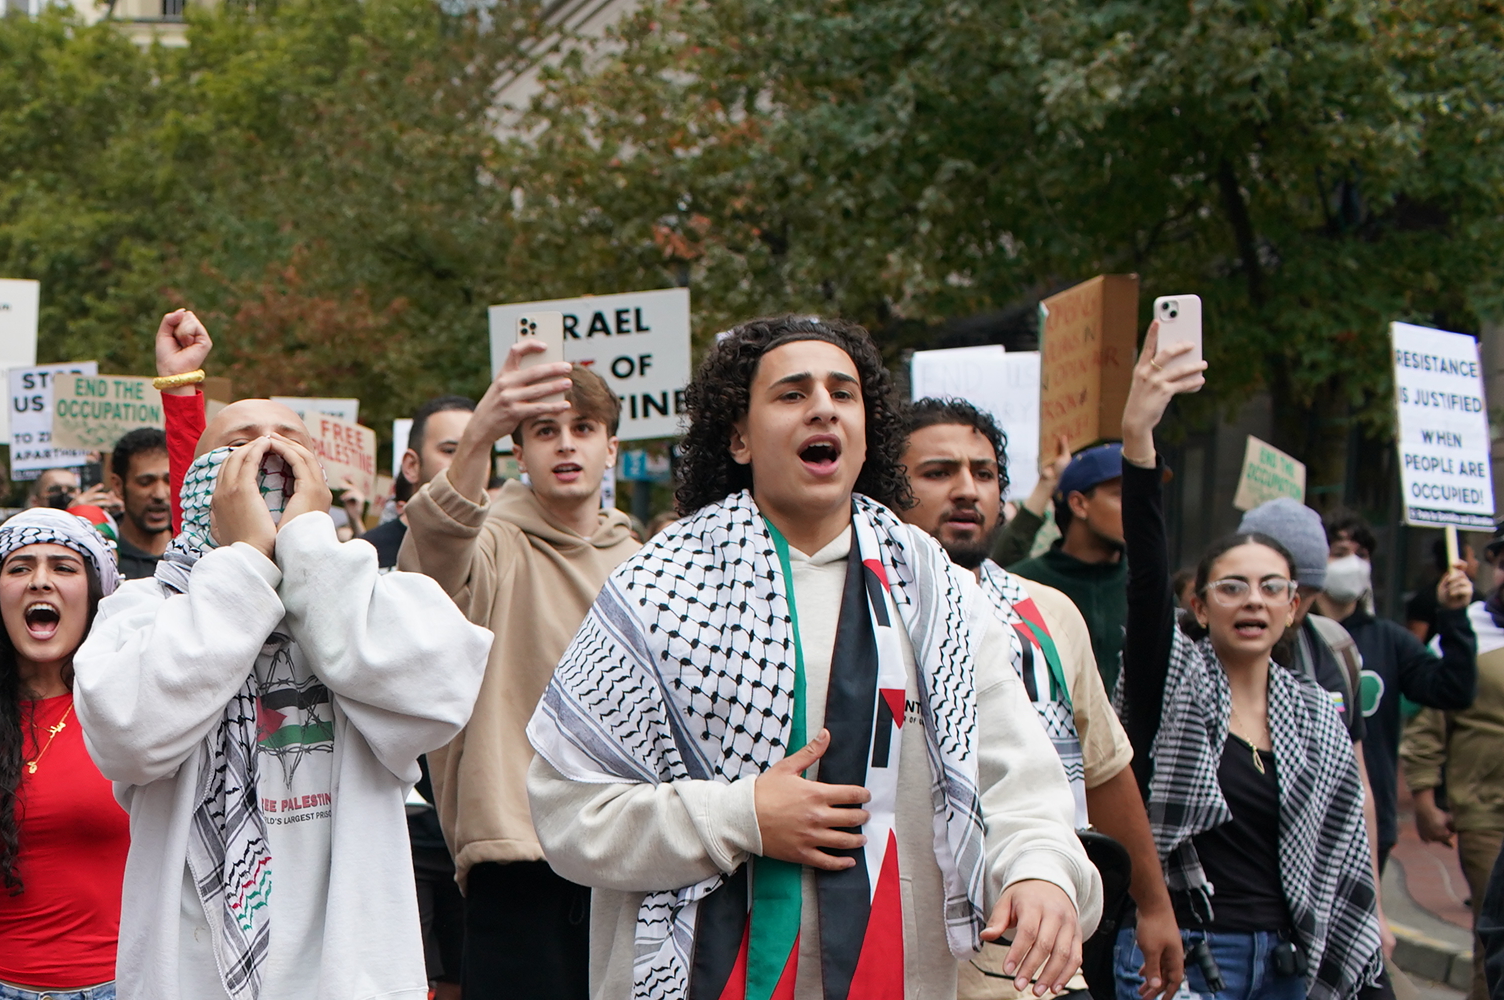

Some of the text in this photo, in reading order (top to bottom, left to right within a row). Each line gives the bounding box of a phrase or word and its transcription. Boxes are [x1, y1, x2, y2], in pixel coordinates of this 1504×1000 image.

[564, 307, 650, 341] RAEL
[611, 354, 653, 380] OF
[1396, 349, 1480, 378] RESISTANCE
[22, 368, 83, 391] ST
[74, 377, 145, 400] END THE
[13, 394, 45, 413] US
[56, 399, 161, 423] OCCUPATION
[1414, 390, 1483, 413] JUSTIFIED
[319, 419, 366, 452] FREE
[1421, 429, 1463, 449] WHEN
[1405, 453, 1486, 478] PEOPLE ARE
[1411, 482, 1485, 506] OCCUPIED!
[281, 792, 332, 813] PALESTIN
[284, 813, 315, 825] LARGEST
